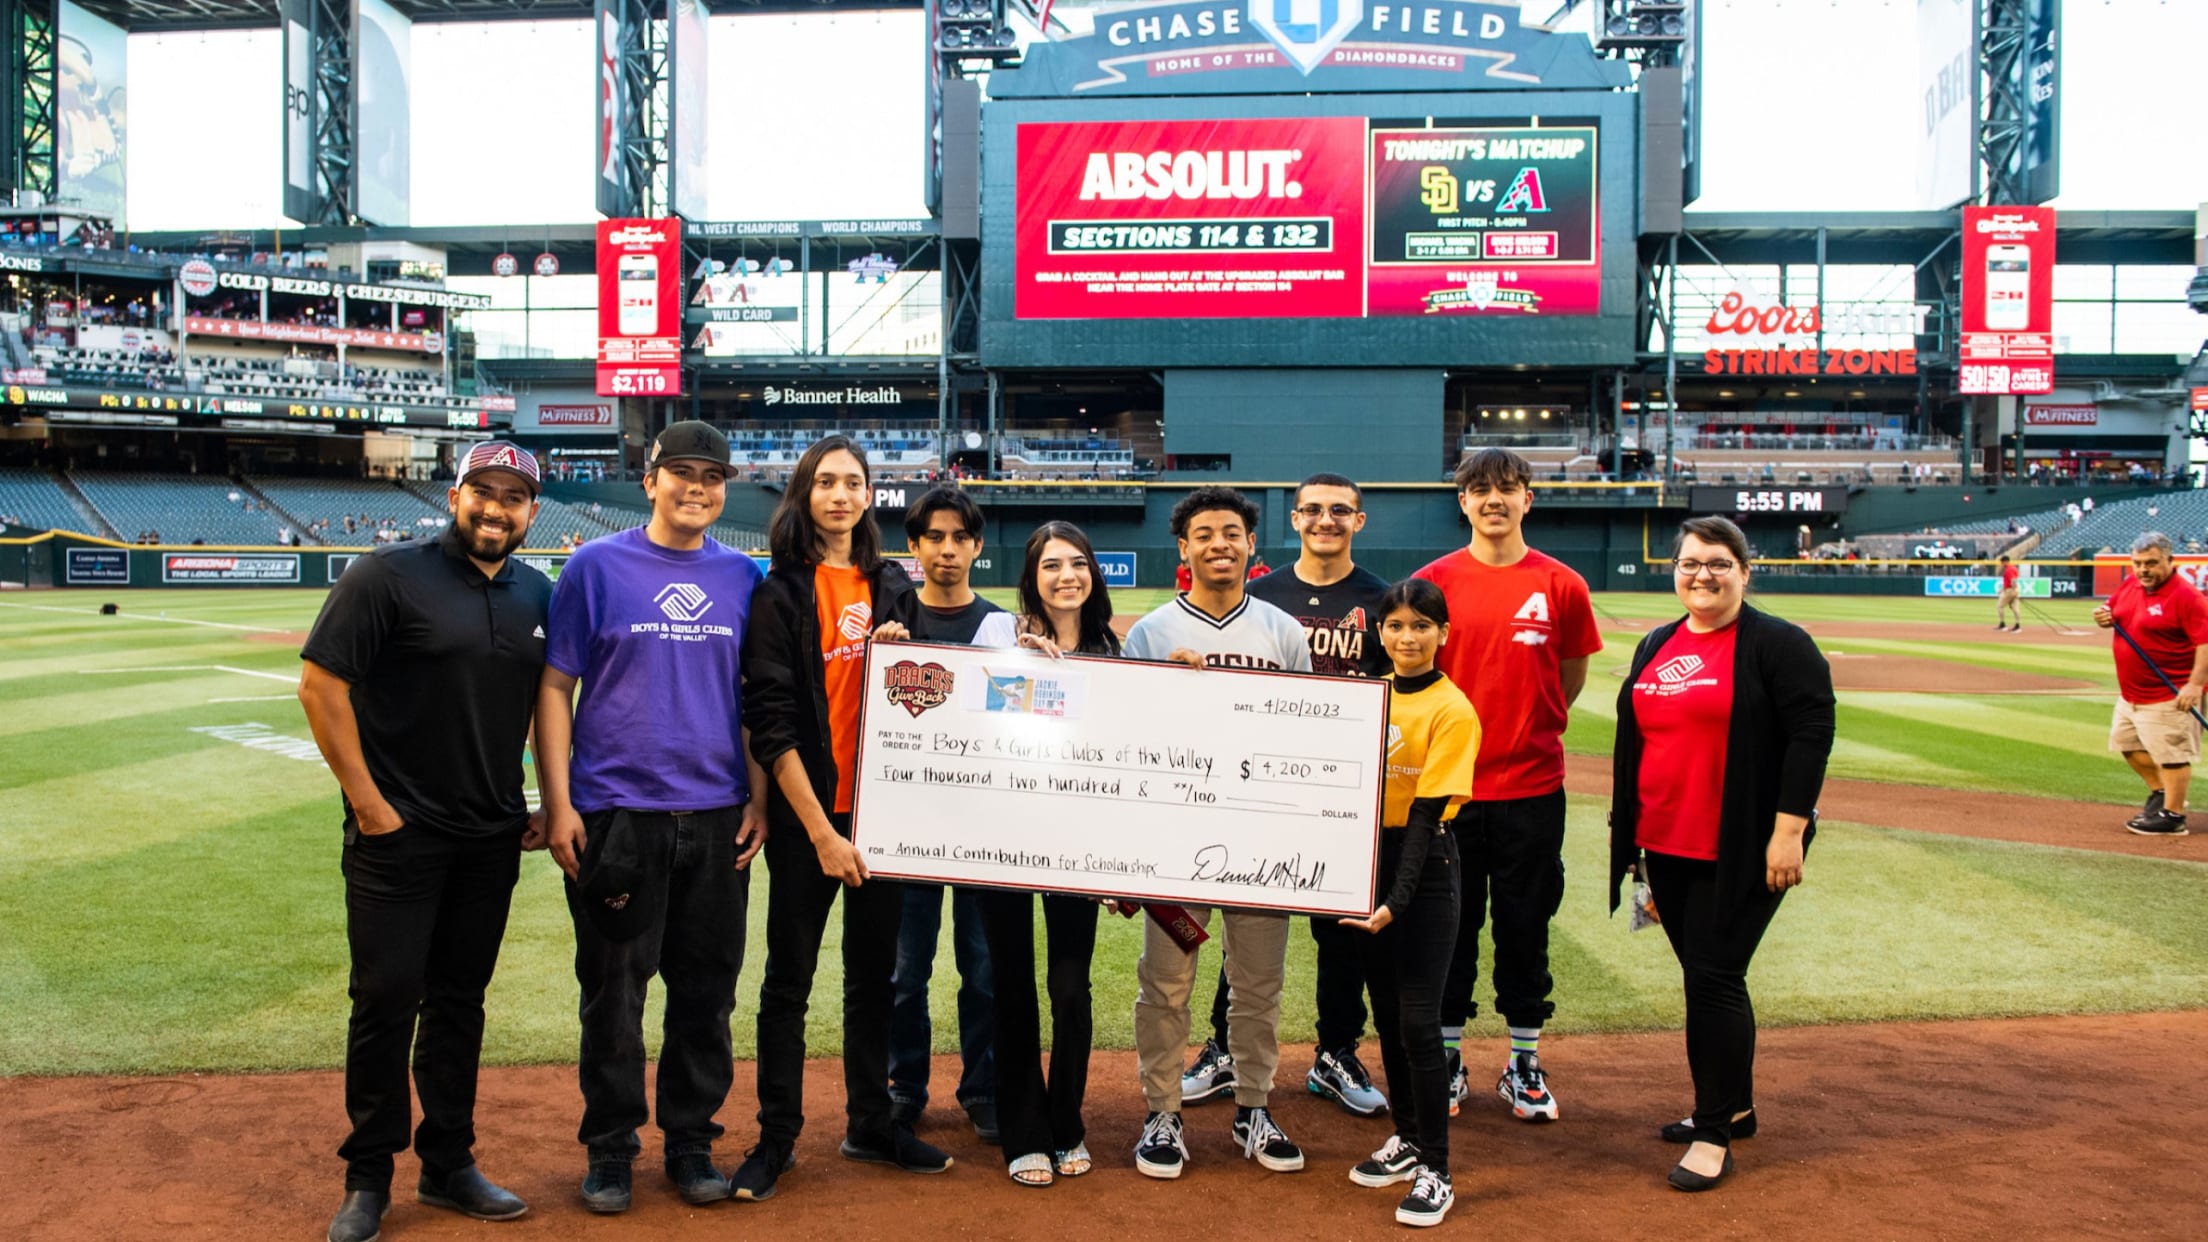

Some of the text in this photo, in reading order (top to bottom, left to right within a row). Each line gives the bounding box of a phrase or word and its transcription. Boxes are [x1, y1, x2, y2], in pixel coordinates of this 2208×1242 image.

[1108, 6, 1506, 47] CHASE FIELD
[1155, 51, 1457, 72] HOME OF THE DIAMONDBACKS
[1384, 138, 1585, 162] TONIGHT'S MATCHUP
[688, 222, 799, 235] NL WEST CHAMPIONS
[822, 220, 922, 233] WORLD CHAMPIONS
[1437, 217, 1461, 227] FIRST
[1462, 217, 1487, 227] PITCH
[1063, 224, 1318, 249] SECTIONS 114 & 132
[1446, 271, 1518, 282] WELCOME TO
[219, 272, 268, 291] COLD
[271, 276, 331, 296] BEERS
[332, 283, 345, 298] &
[346, 284, 492, 311] CHEESEBURGERS
[712, 309, 772, 322] WILD CARD
[1706, 292, 1932, 335] Coors LIGHT
[1704, 347, 1917, 375] STRIKE ZONE
[611, 375, 665, 394] $2,119
[26, 389, 68, 404] WACHA
[784, 386, 901, 404] Banner Health
[224, 400, 262, 414] NELSON
[450, 410, 479, 426] 5:55
[555, 412, 595, 422] FITNESS
[2051, 411, 2097, 423] FITNESS
[875, 489, 905, 507] PM
[1736, 492, 1822, 512] 5:55 PM
[172, 559, 288, 570] ARIZONA SPORTS
[974, 559, 992, 569] 413
[1617, 564, 1636, 575] 413
[171, 570, 292, 578] THE LOCAL SPORTS LEADER
[1940, 579, 1980, 594] COX
[2053, 581, 2076, 593] 374
[631, 623, 733, 637] BOYS & GIRLS CLUBS
[670, 633, 682, 641] THE
[682, 634, 707, 642] VALLEY
[1305, 627, 1363, 660] ZONA
[887, 687, 946, 708] Give Back
[1234, 703, 1254, 713] DATE
[1264, 698, 1340, 717] 4/20/2023
[879, 731, 922, 741] PAY TO THE
[882, 741, 922, 750] ORDER OF
[934, 732, 984, 757] Boys
[1060, 738, 1104, 762] Clubs
[1115, 744, 1131, 763] of
[1138, 745, 1161, 766] the
[1167, 746, 1213, 784] Valley
[1240, 759, 1251, 782] $
[1262, 761, 1311, 778] 4,200
[884, 765, 914, 782] Four
[924, 767, 992, 785] thousand
[1008, 772, 1038, 790] two
[1049, 774, 1120, 795] hundred
[1138, 780, 1149, 797] &
[1321, 809, 1358, 820] DOLLARS
[868, 846, 884, 855] FOR
[895, 842, 1157, 877] Annual Contribution for Scholarships
